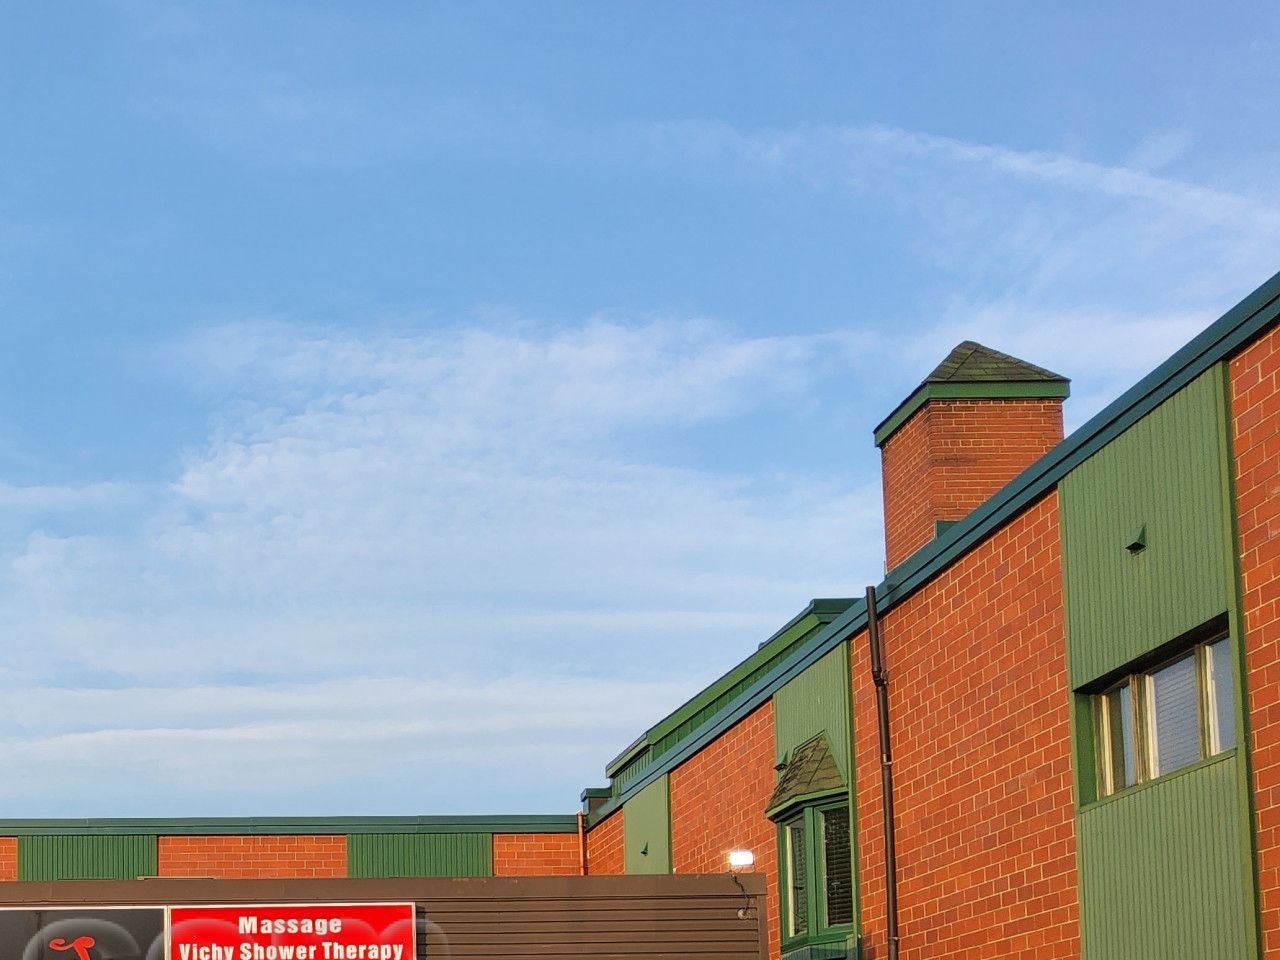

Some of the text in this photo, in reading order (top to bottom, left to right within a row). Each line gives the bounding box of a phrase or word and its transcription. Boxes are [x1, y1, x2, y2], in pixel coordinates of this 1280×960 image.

[238, 916, 342, 935] Massage
[239, 942, 317, 960] Shower
[321, 941, 404, 960] Therapy
